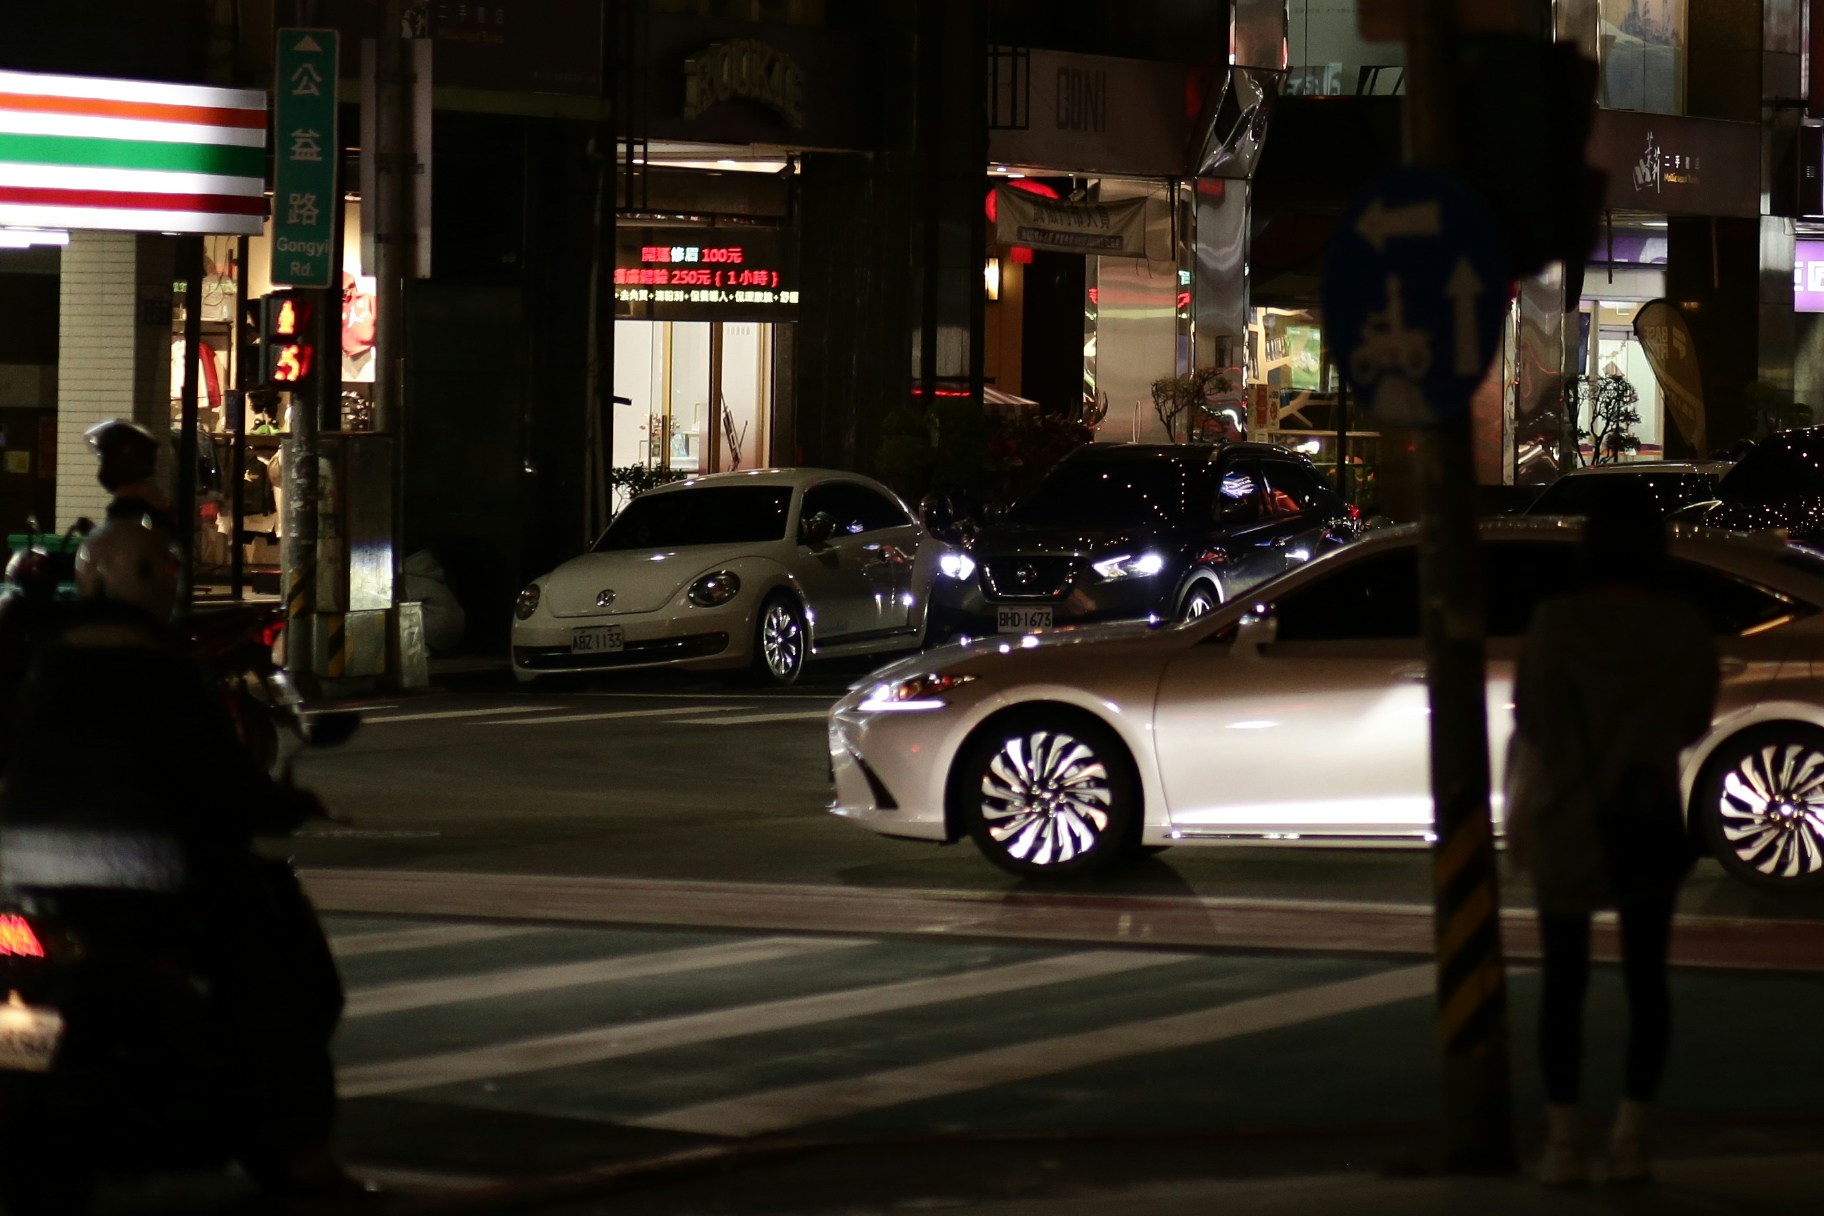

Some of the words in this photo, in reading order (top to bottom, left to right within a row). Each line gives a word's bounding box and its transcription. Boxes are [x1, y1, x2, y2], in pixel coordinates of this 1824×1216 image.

[1055, 65, 1106, 133] CONI
[285, 63, 324, 226] 公益路
[276, 237, 329, 258] Gongyi
[701, 247, 744, 264] 100元
[671, 268, 712, 285] 250元
[998, 611, 1051, 629] BHD-1673
